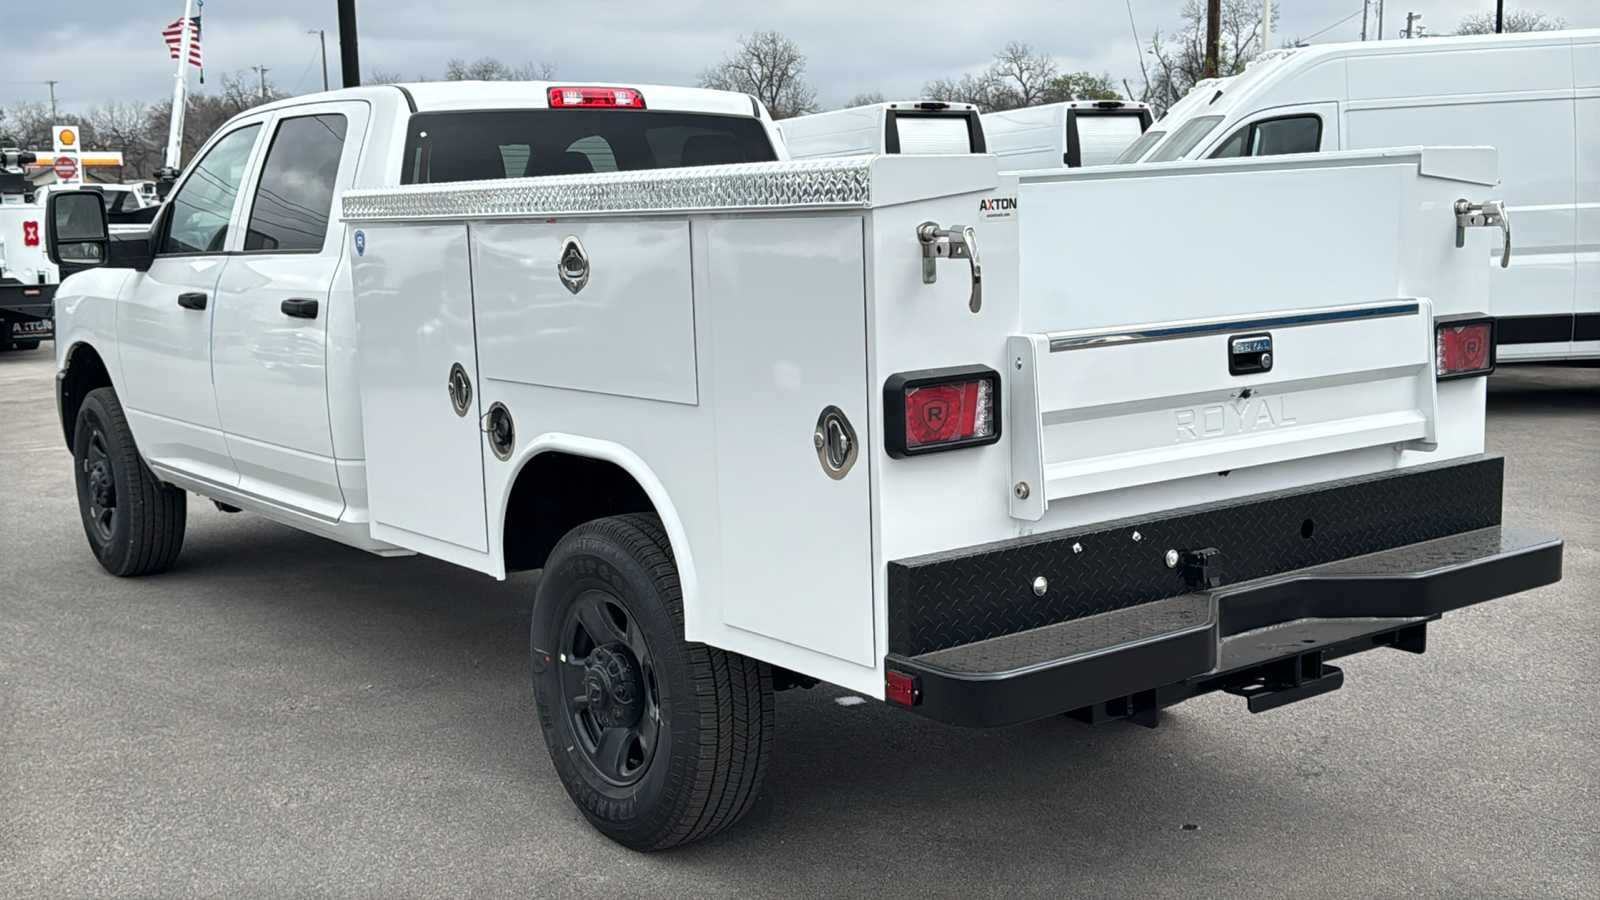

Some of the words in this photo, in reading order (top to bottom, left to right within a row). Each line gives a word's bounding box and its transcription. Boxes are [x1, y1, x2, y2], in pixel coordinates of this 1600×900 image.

[979, 197, 1017, 211] AXTON
[357, 236, 364, 248] R
[1466, 341, 1477, 354] R
[927, 406, 943, 422] R
[1174, 396, 1297, 442] ROYAL
